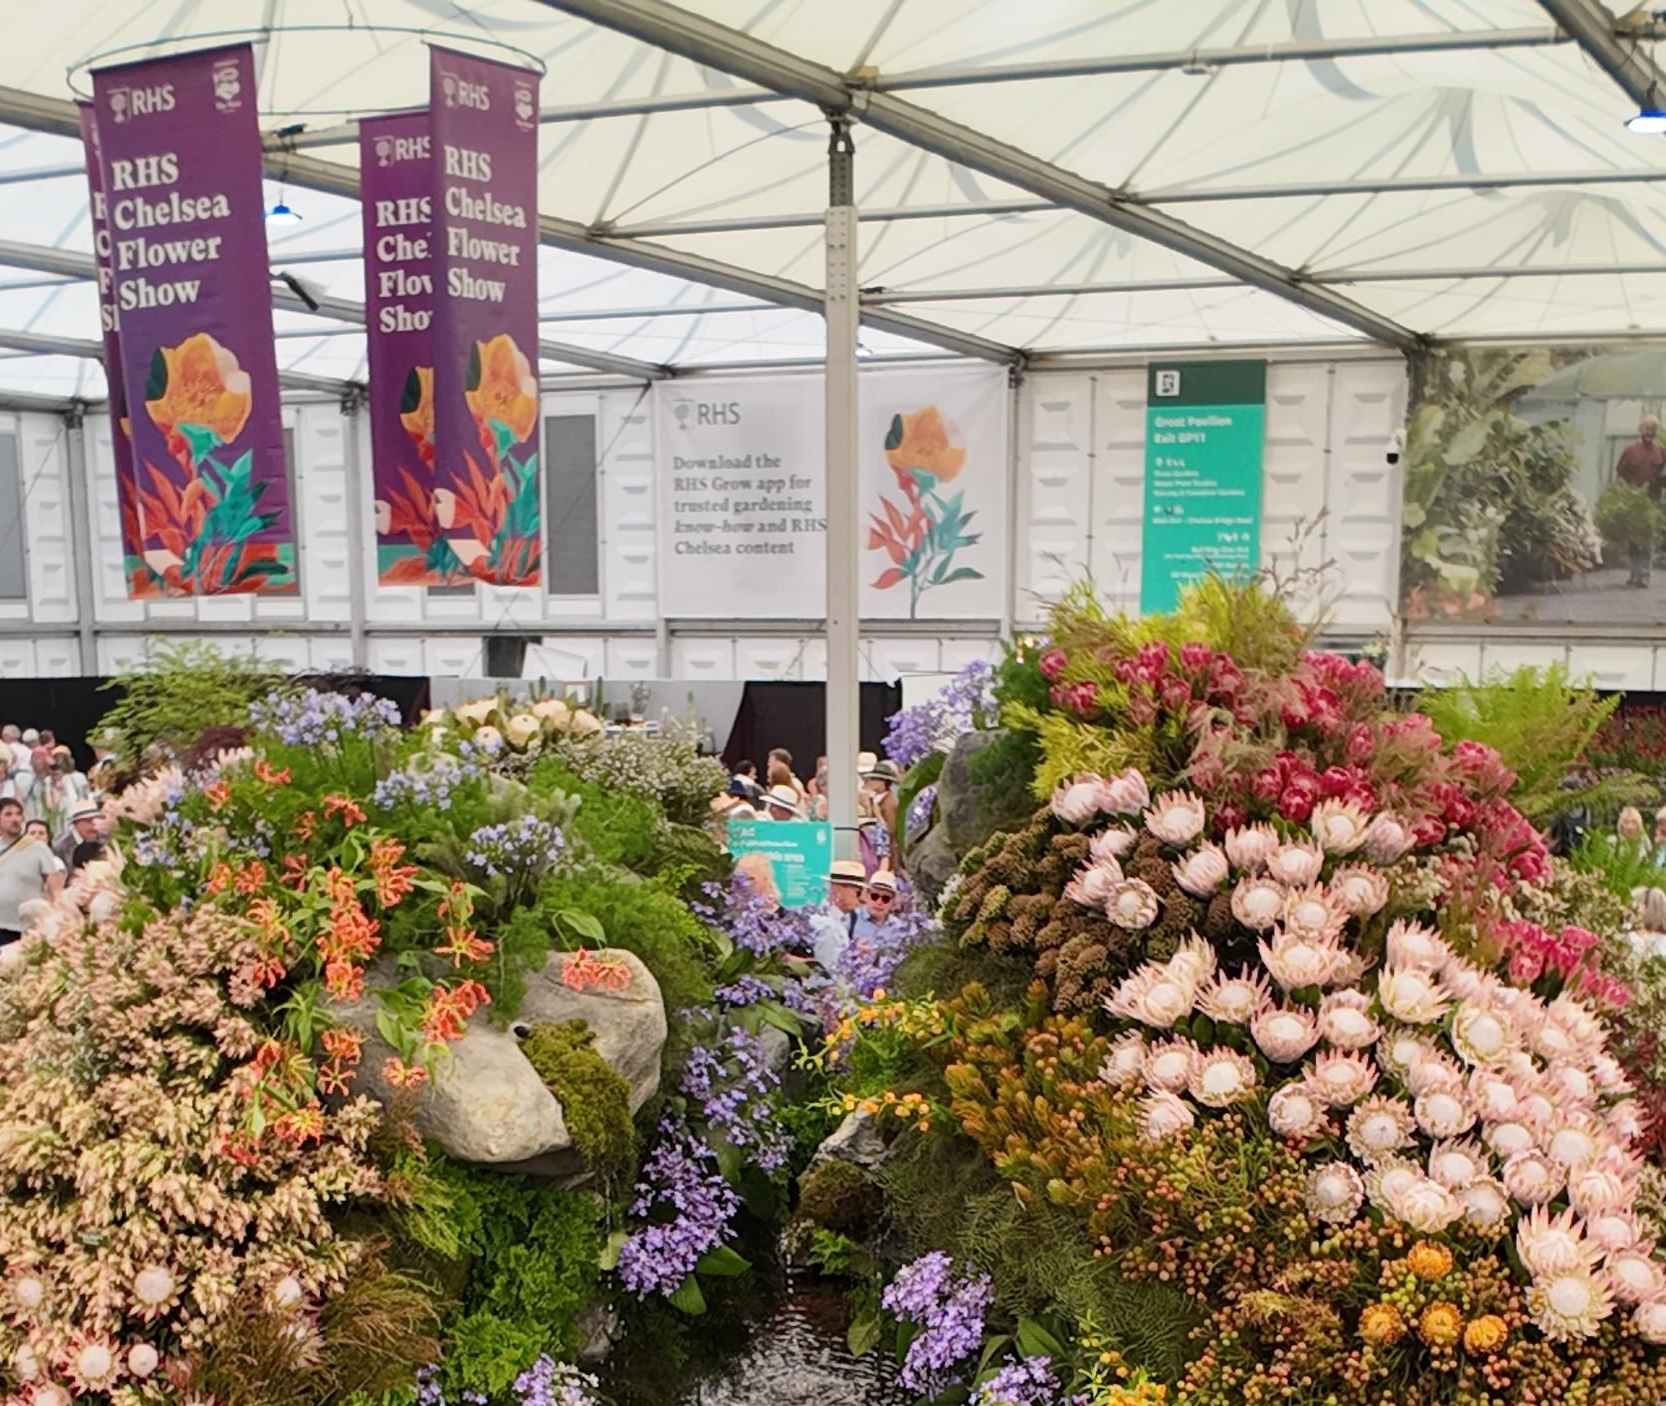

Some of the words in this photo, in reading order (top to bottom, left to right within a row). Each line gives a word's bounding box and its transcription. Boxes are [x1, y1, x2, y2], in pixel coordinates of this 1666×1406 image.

[133, 85, 176, 116] RHS
[459, 81, 490, 111] RHS
[111, 152, 180, 191] RHS
[443, 145, 492, 182] RHS
[114, 192, 231, 231] Chelsea
[376, 196, 431, 227] RHS
[445, 186, 527, 228] Chelsea
[117, 235, 222, 272] Flower
[446, 226, 521, 266] Flower
[119, 276, 201, 311] Show
[447, 267, 506, 303] Show
[697, 402, 741, 426] RHS
[673, 454, 752, 471] Download
[755, 453, 781, 469] the
[673, 477, 708, 492] RHS
[712, 476, 753, 491] Grow
[757, 478, 786, 494] app
[789, 474, 812, 490] for
[674, 498, 730, 513] trusted
[733, 497, 813, 515] gardening
[674, 518, 755, 534] know-how
[757, 517, 787, 533] and
[791, 517, 828, 533] RHS
[674, 540, 731, 555] Chelsea
[735, 541, 795, 555] content
